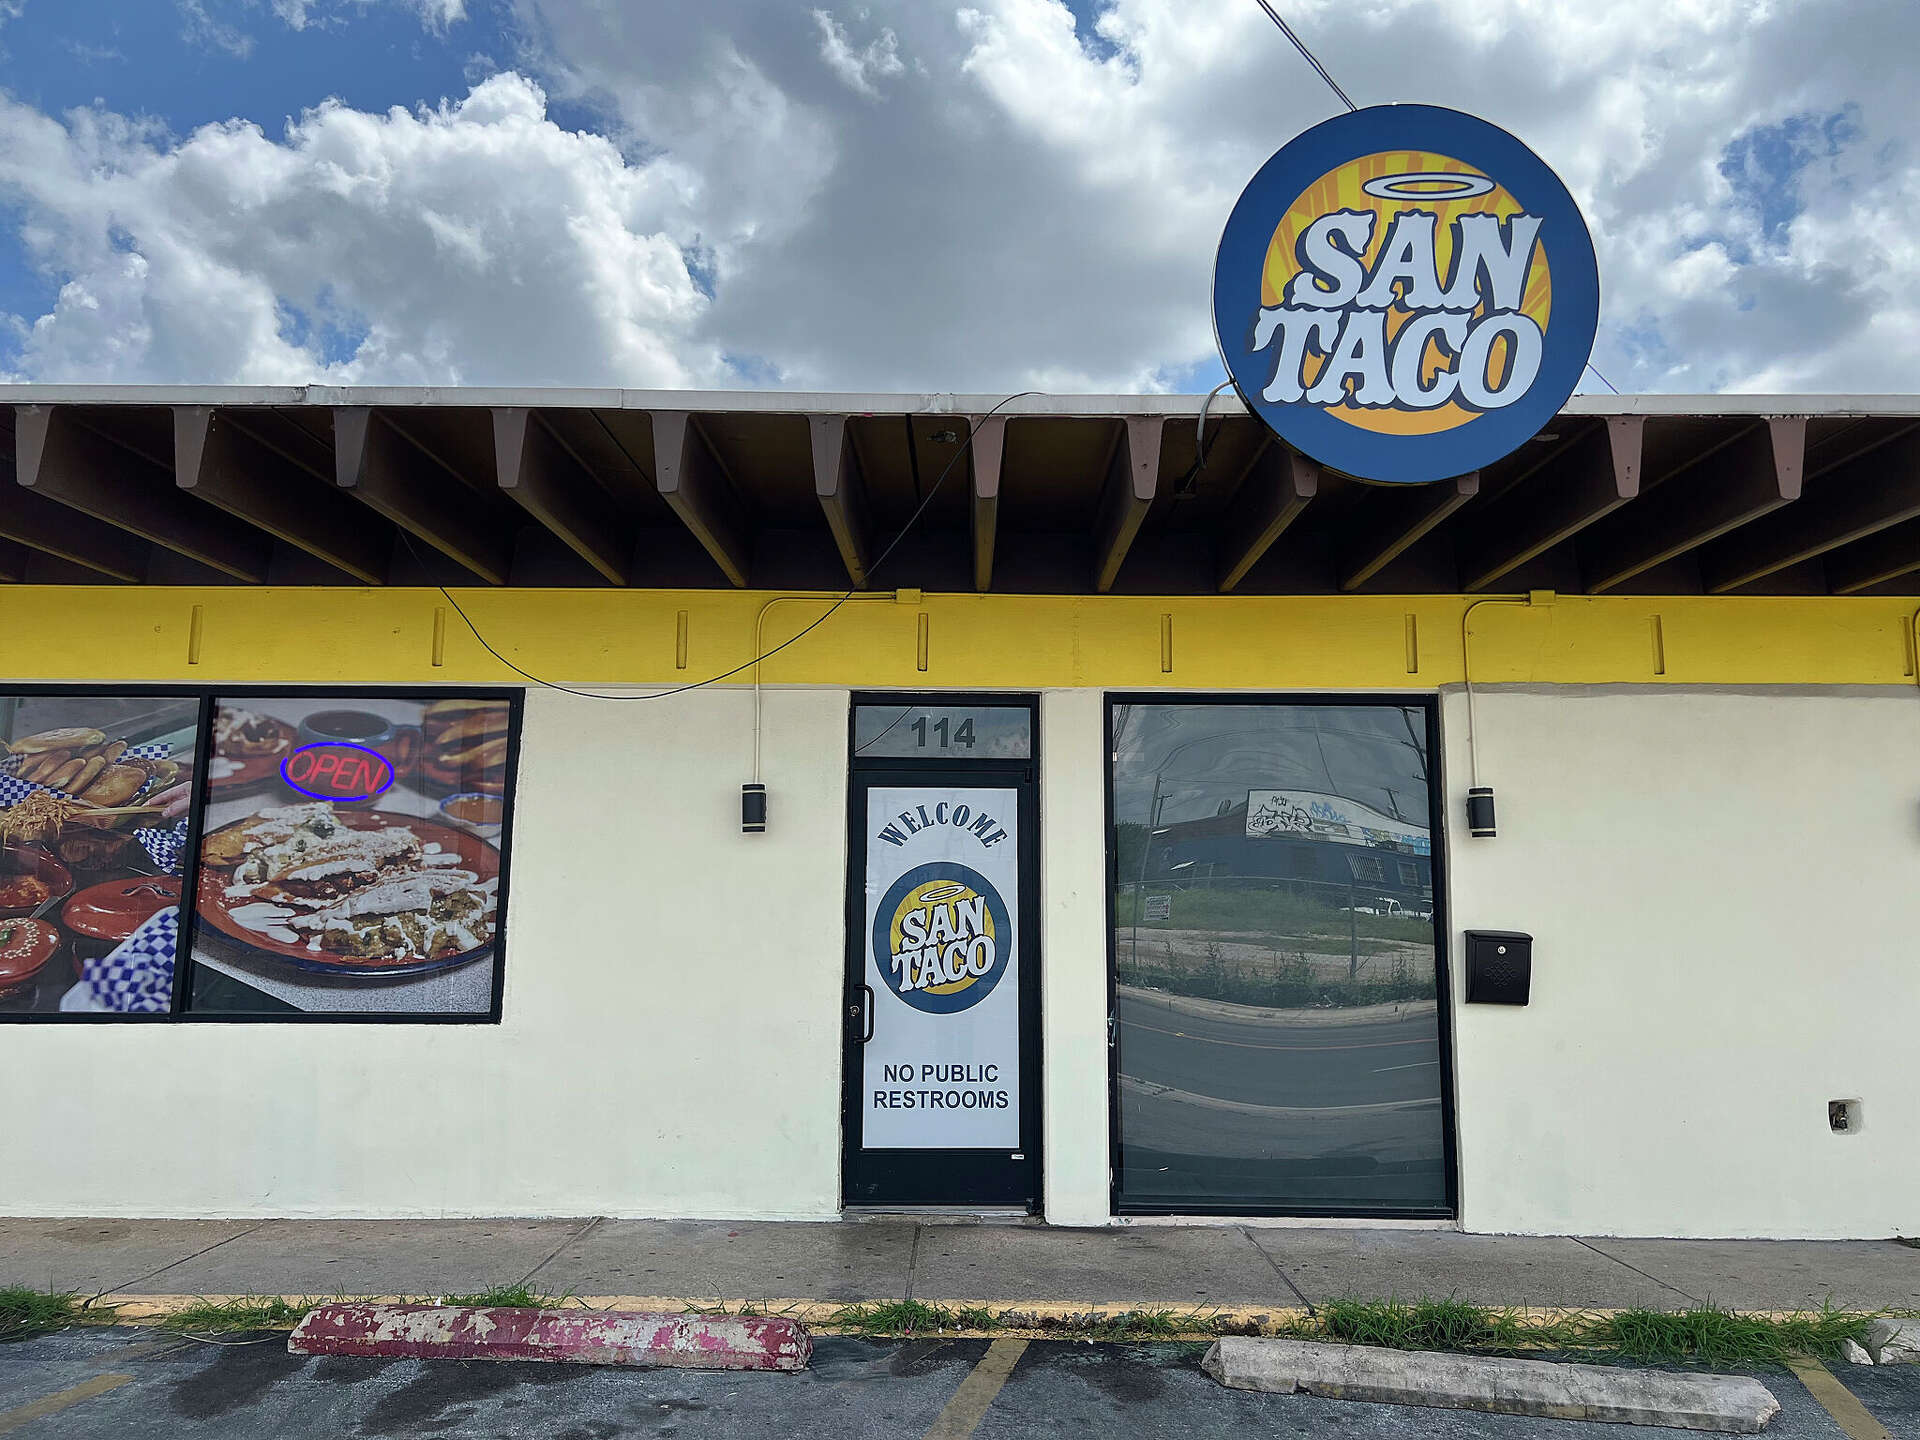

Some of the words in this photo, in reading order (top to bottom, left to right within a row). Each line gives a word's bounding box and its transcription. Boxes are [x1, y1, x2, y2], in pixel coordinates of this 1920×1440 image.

[1286, 208, 1544, 311] SAN
[1252, 305, 1544, 410] TACO
[911, 716, 976, 748] 114
[287, 751, 386, 793] OPEN
[877, 801, 1008, 848] WELCOME
[901, 895, 985, 952] SAN
[891, 935, 996, 992] TACO
[884, 1064, 915, 1082] NO
[922, 1064, 999, 1082] PUBLIC
[874, 1090, 1009, 1108] RESTROOMS
